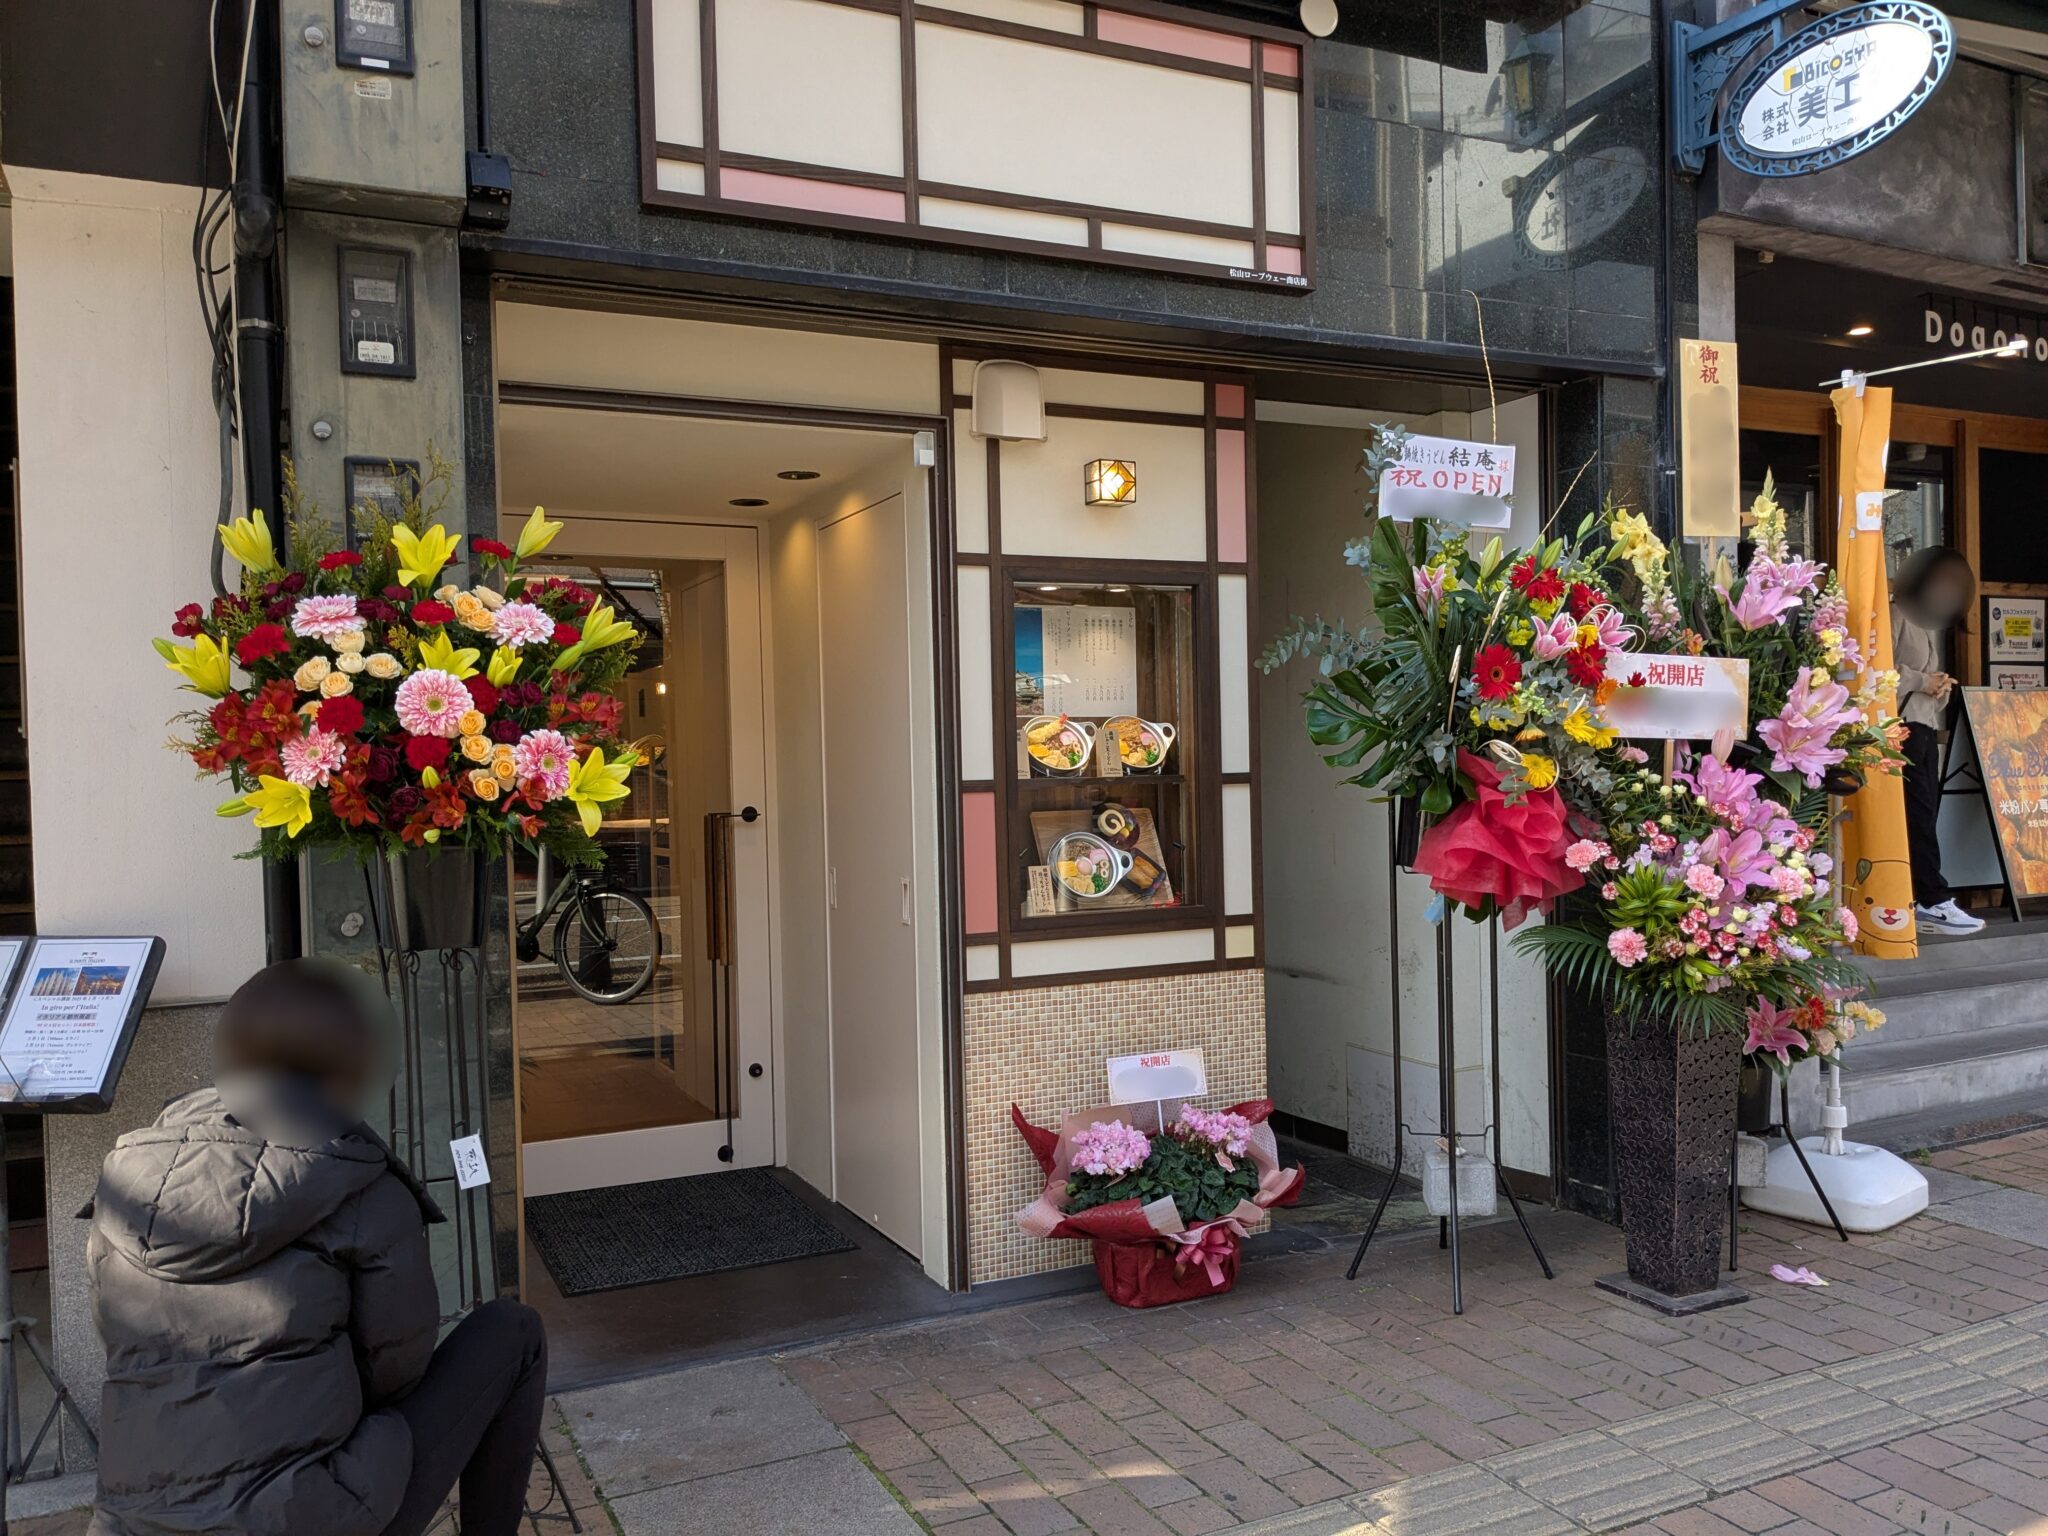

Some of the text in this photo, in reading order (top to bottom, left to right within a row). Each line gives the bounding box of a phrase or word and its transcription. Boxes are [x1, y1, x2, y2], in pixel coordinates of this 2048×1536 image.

[1761, 101, 1790, 124] 株式
[1762, 119, 1790, 142] 会社
[1229, 268, 1308, 287] 松山ロープウェー商店街
[1699, 345, 1720, 384] 御祝
[1390, 465, 1502, 494] 祝 OPEN
[1647, 662, 1705, 687] 祝開店
[1140, 1055, 1171, 1068] 祝開店
